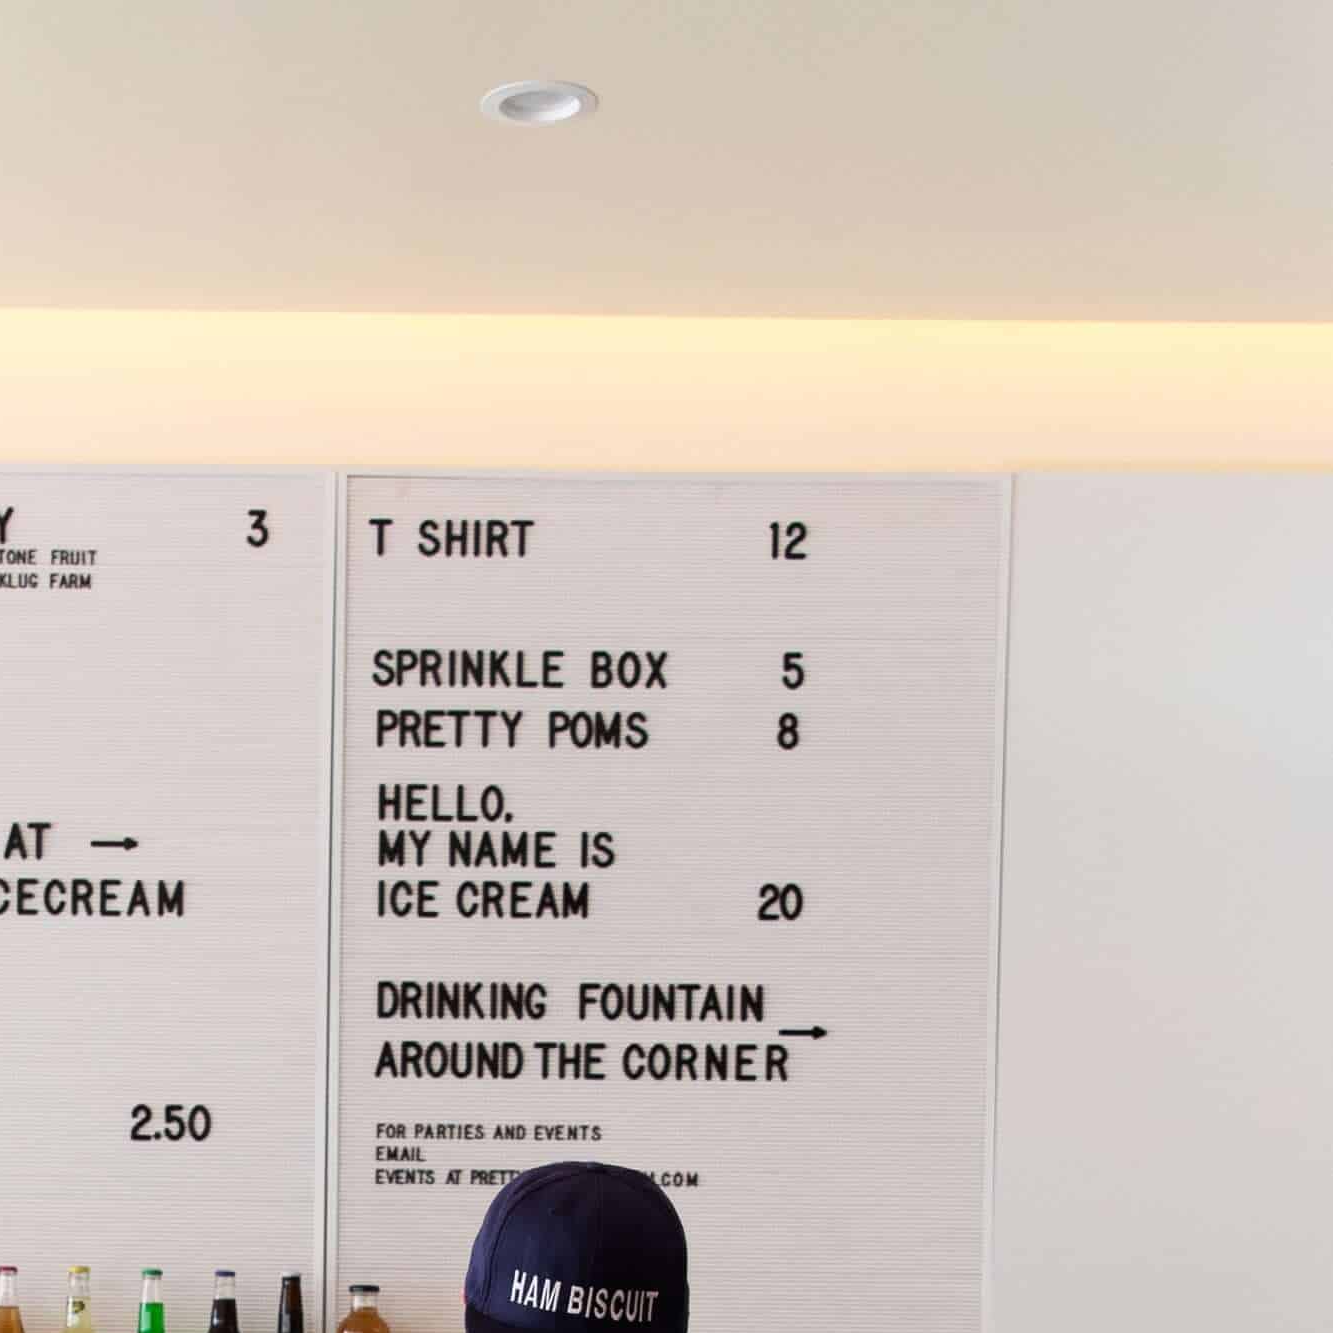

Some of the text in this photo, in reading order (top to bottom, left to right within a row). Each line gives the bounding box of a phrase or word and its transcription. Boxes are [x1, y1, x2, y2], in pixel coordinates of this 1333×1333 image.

[246, 509, 270, 548] 3
[368, 518, 535, 558] T SHIRT
[769, 521, 808, 561] 12
[50, 549, 97, 566] FRUIT
[49, 572, 92, 589] FARM
[372, 648, 668, 689] SPRINKLE BOX
[781, 651, 805, 691] 5
[376, 709, 649, 750] PRETTY POMS
[776, 712, 800, 751] 8
[3, 821, 52, 861] AT
[378, 829, 616, 869] MY NAME IS
[377, 879, 590, 919] ICE CREAM
[757, 883, 804, 921] 20
[376, 980, 764, 1023] DRINKING FOUNTAIN
[374, 1040, 789, 1082] AROUND THE CORNER
[130, 1103, 212, 1142] 2.50
[376, 1122, 602, 1142] FOR PARTIES AND EVENTS
[375, 1145, 426, 1162] EMAIL
[374, 1168, 436, 1185] EVENTS
[445, 1168, 463, 1185] AT
[510, 1269, 660, 1323] HAM BISCUIT
